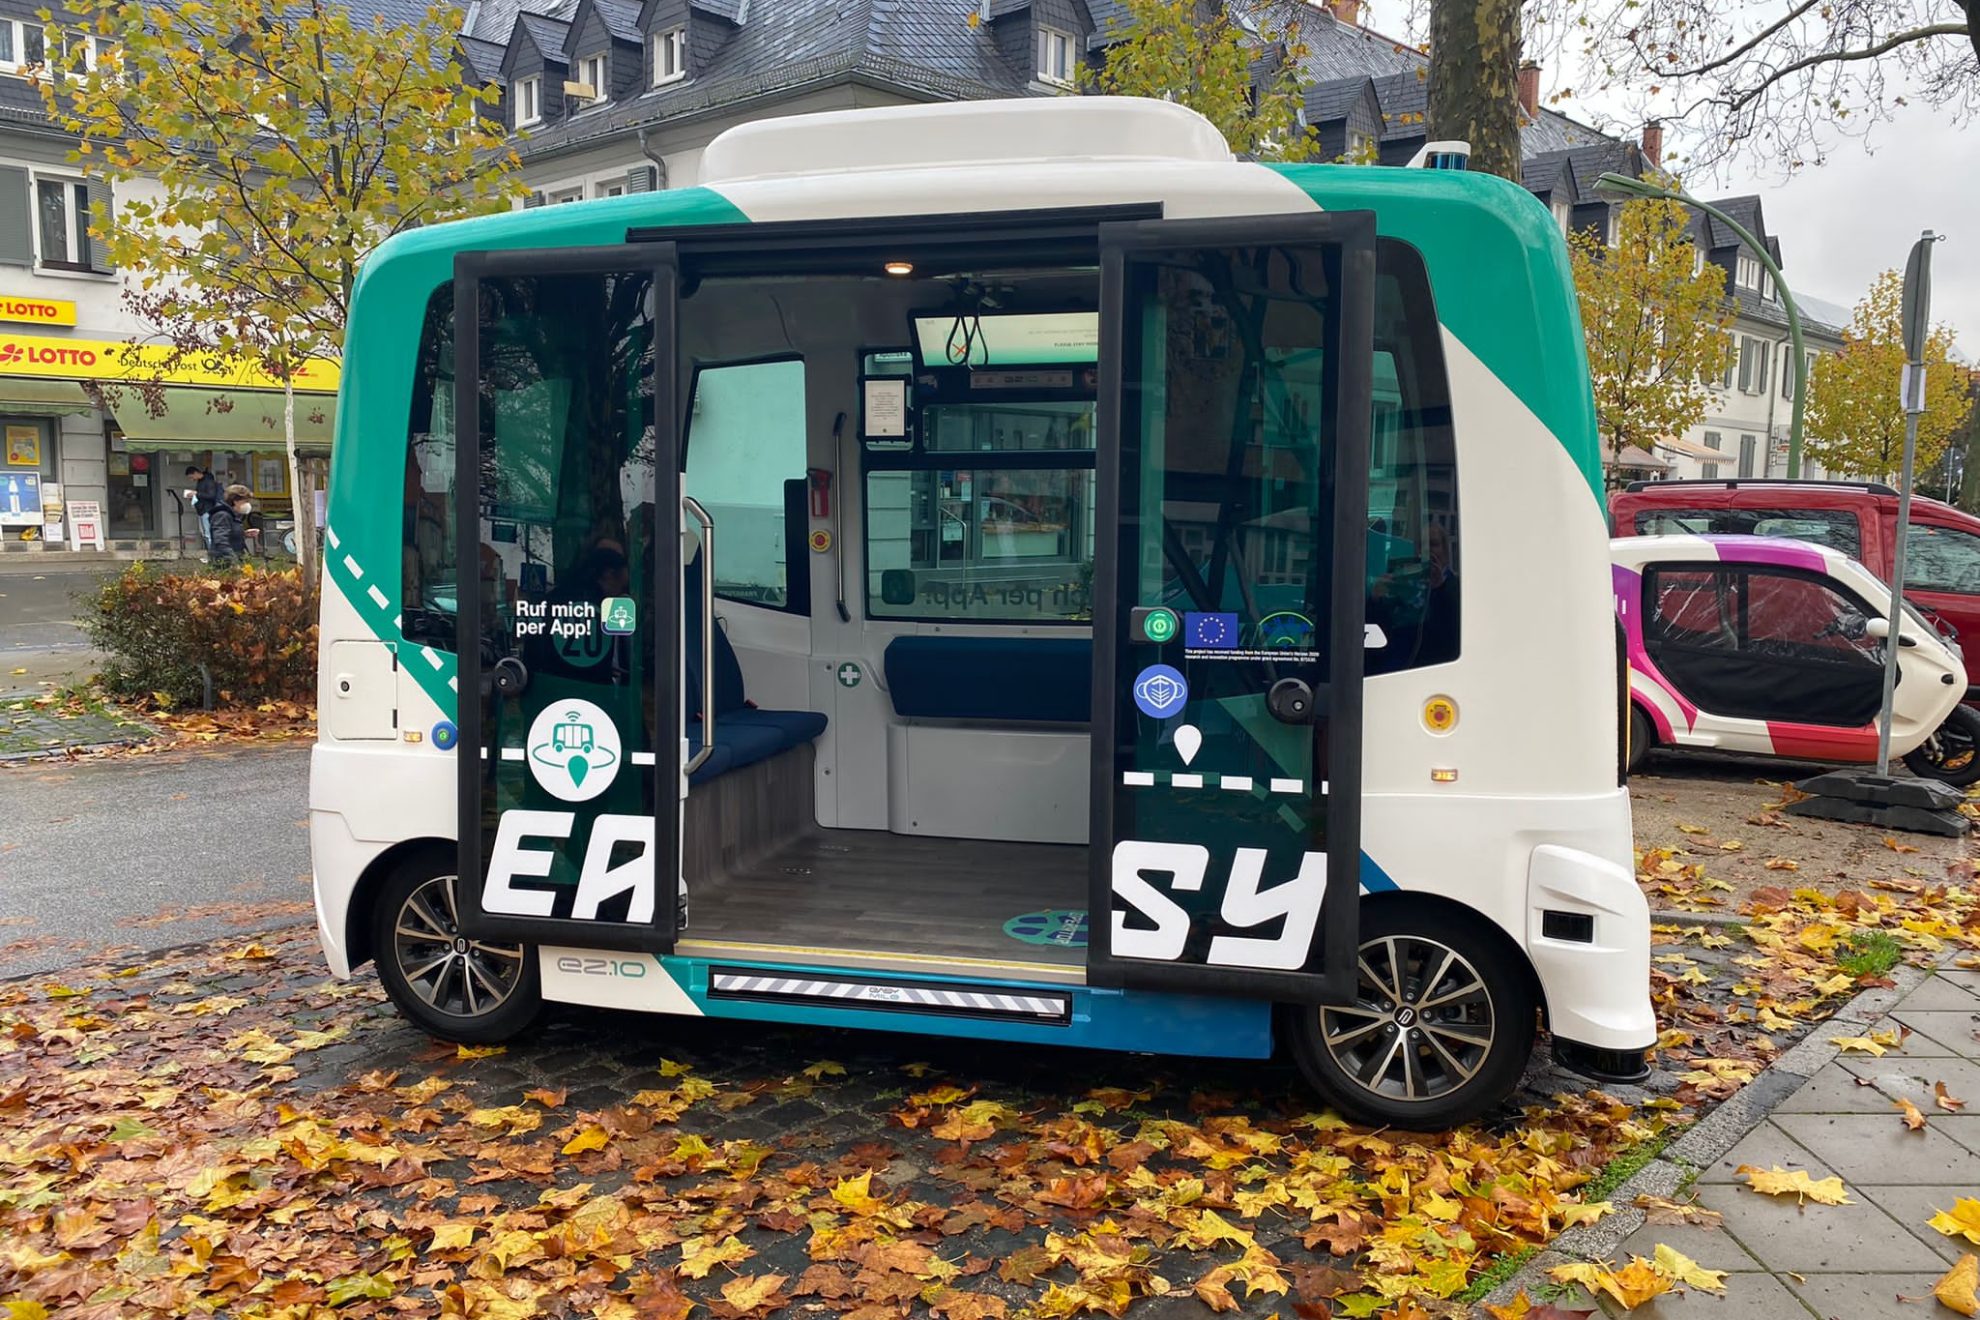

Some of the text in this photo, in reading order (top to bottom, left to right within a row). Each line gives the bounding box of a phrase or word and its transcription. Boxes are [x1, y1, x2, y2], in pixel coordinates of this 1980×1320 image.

[7, 302, 57, 317] LOTTO
[28, 347, 96, 366] LOTTO
[175, 360, 197, 371] Post
[516, 600, 595, 618] Ruf mich
[516, 621, 546, 638] per
[550, 619, 591, 639] App!
[481, 809, 655, 923] EA
[1111, 840, 1328, 971] SY
